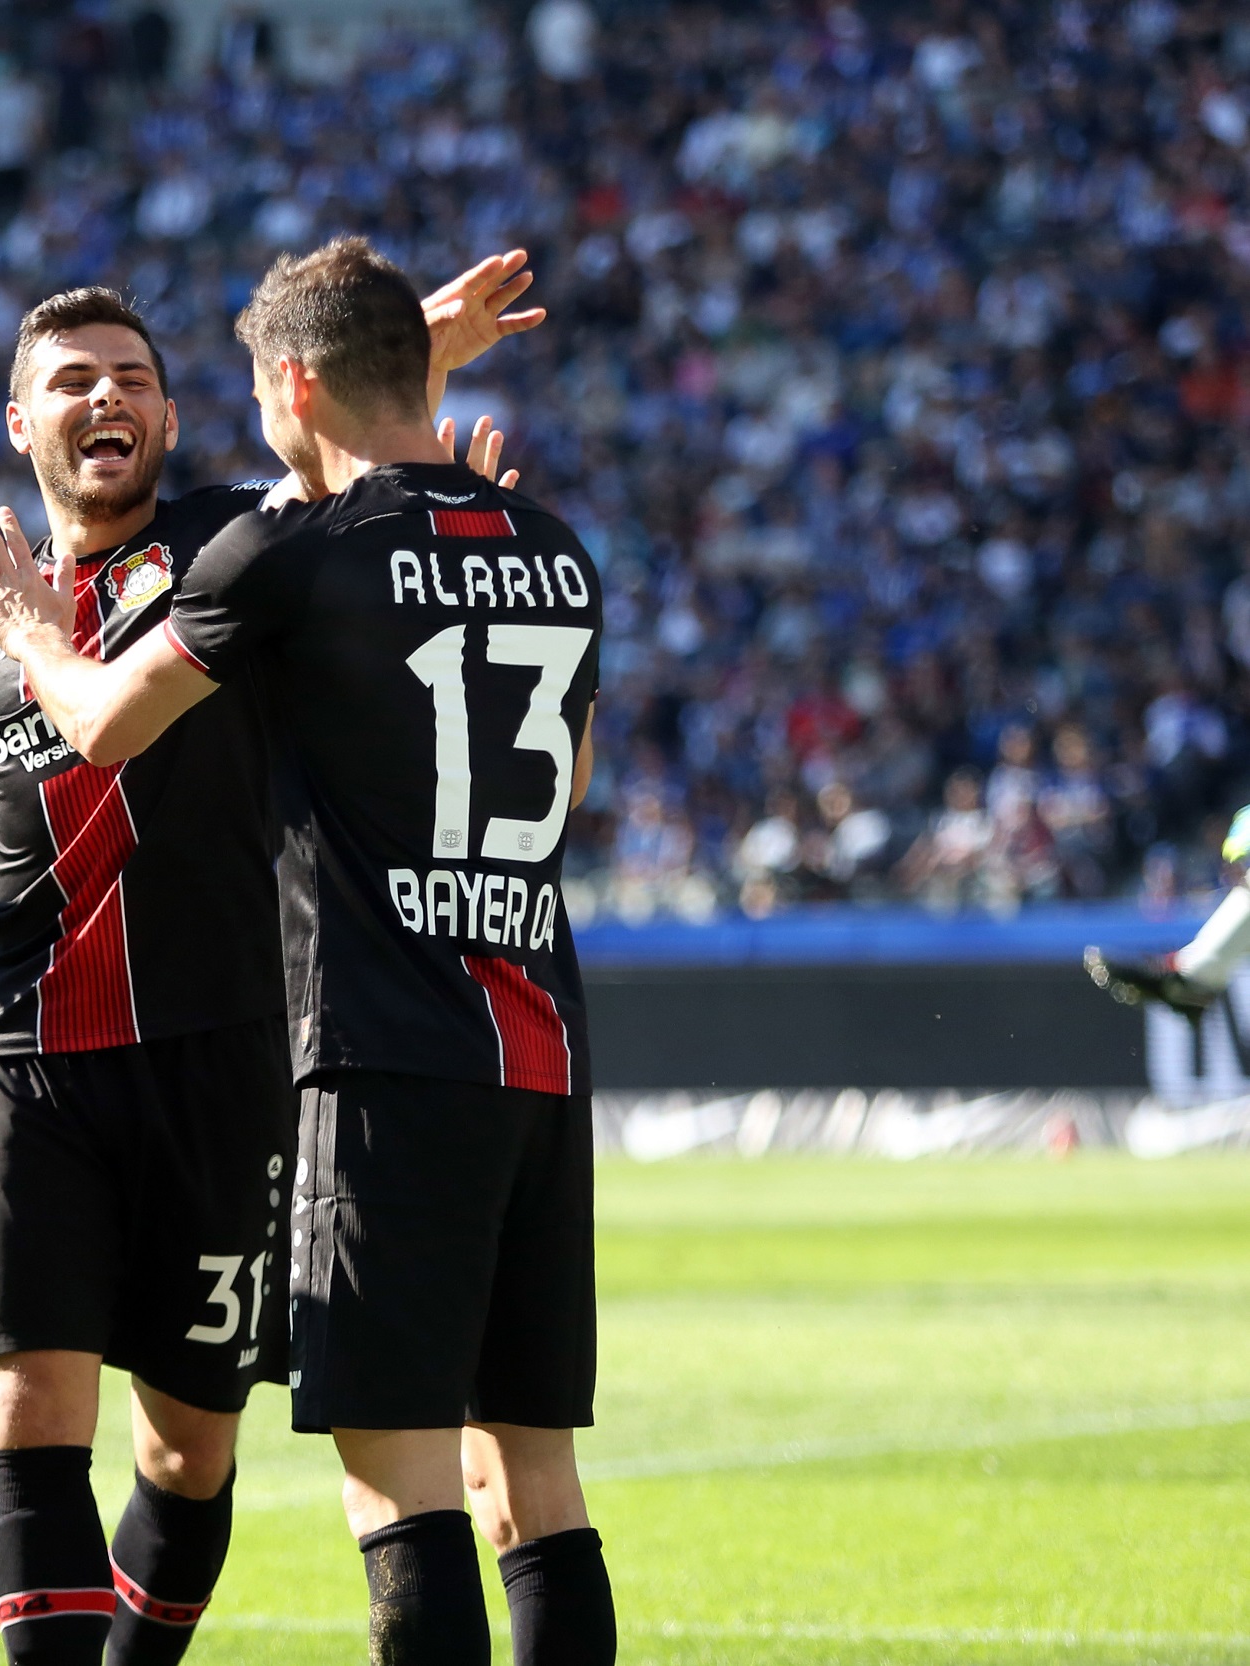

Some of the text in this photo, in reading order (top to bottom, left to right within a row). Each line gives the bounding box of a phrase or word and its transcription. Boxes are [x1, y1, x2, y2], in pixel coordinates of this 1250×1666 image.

[390, 550, 589, 608] ALARIO
[405, 623, 595, 863] 13
[388, 868, 528, 948] BAYER
[185, 1250, 267, 1345] 31
